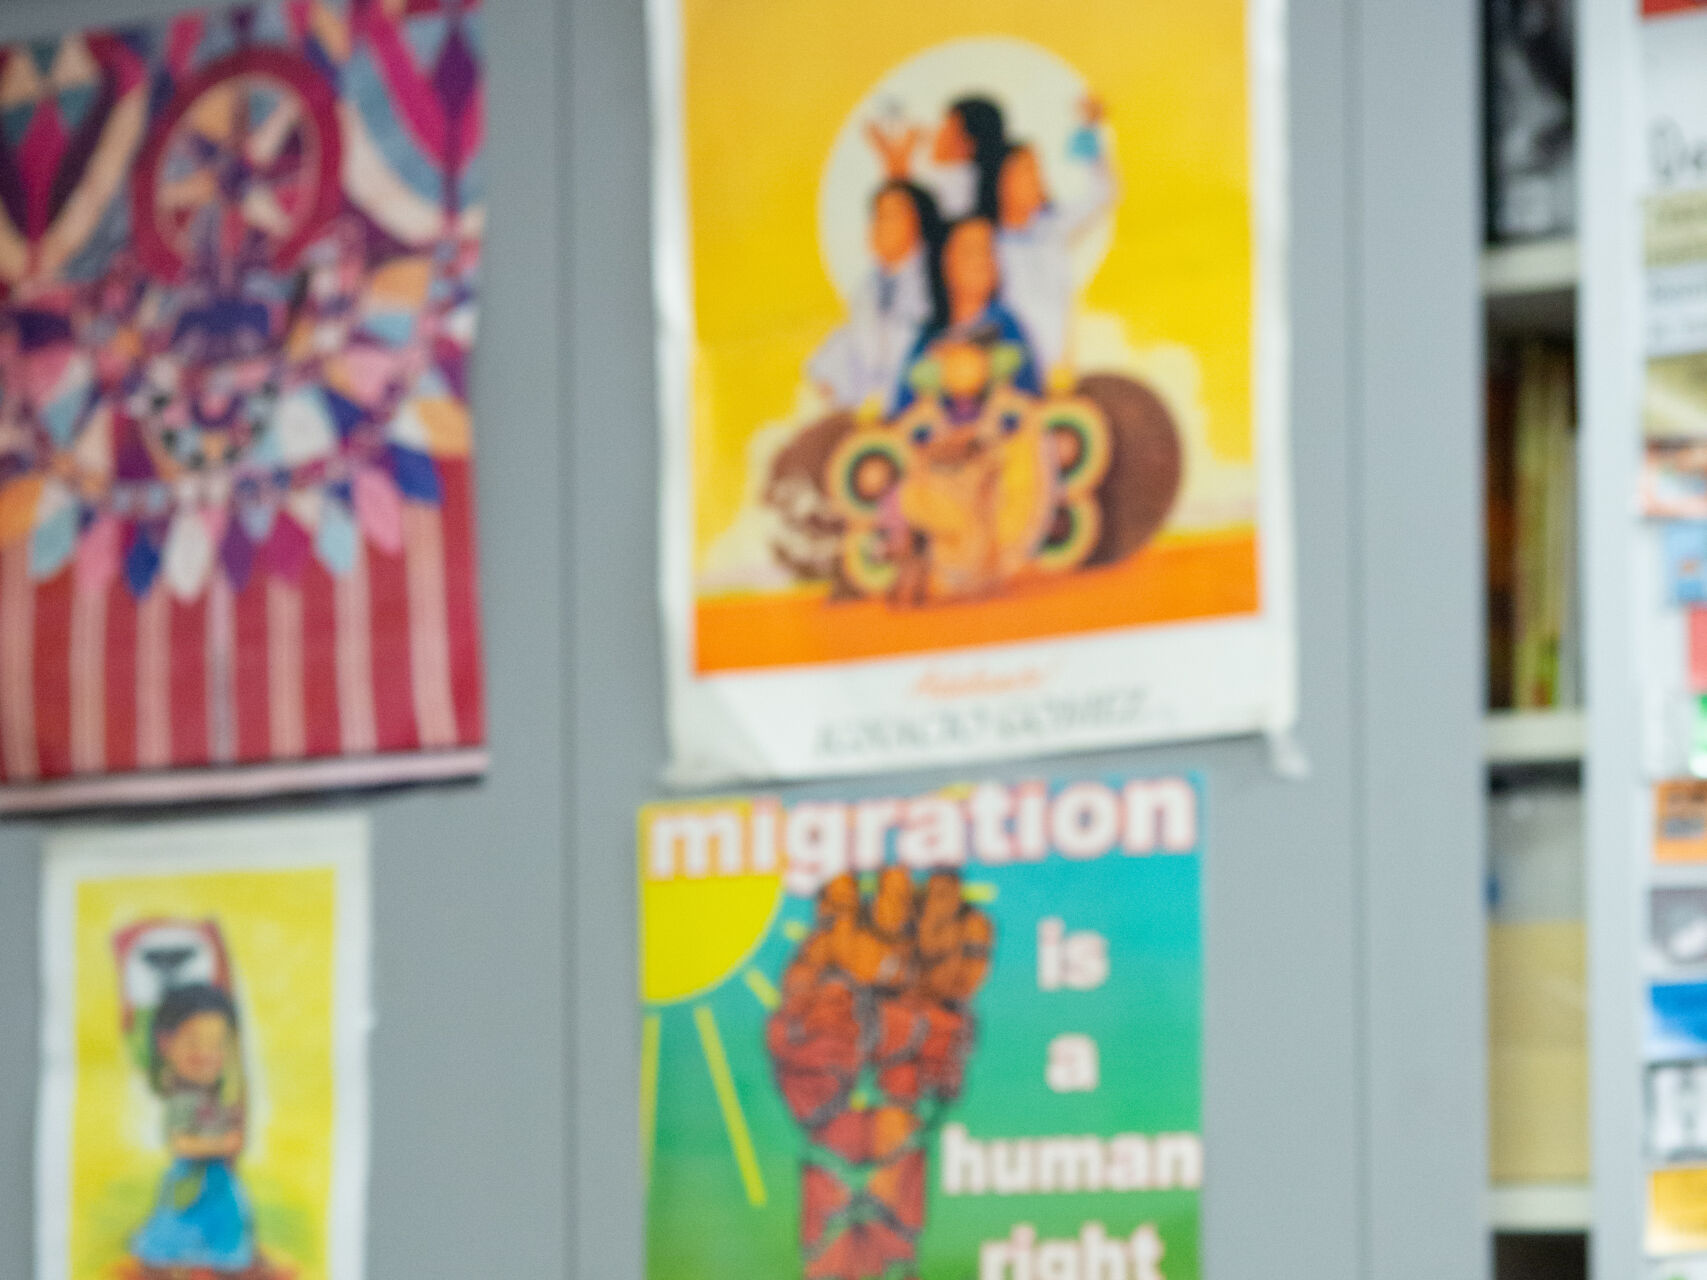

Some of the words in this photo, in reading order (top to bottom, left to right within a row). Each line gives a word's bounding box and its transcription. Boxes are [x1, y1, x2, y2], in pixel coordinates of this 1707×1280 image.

[649, 778, 1197, 896] migration
[1037, 916, 1110, 992] is
[1045, 1033, 1099, 1093] a
[940, 1122, 1202, 1196] human
